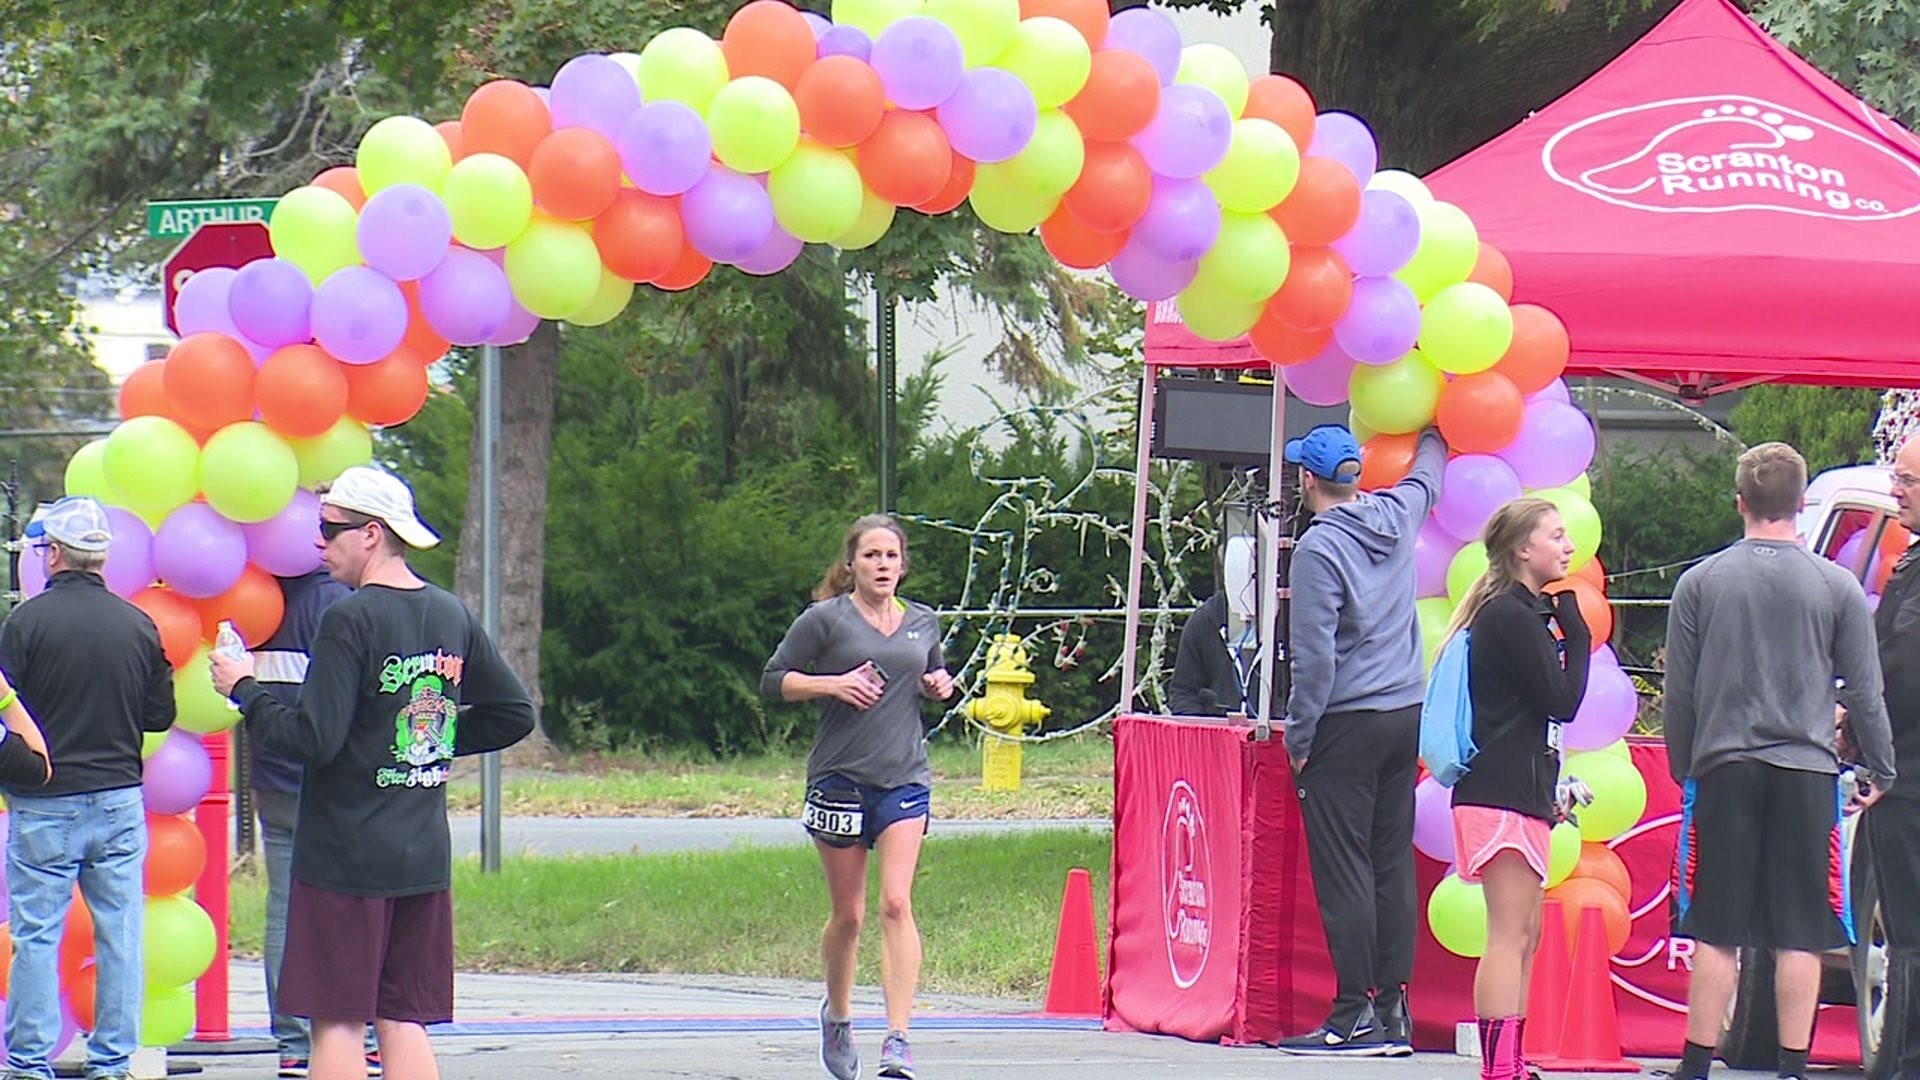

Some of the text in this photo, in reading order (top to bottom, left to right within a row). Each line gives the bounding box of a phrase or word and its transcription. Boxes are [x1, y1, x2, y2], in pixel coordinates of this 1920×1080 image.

[1656, 151, 1846, 187] Scranton
[1660, 173, 1851, 210] Running
[159, 205, 264, 234] ARTHUR
[806, 806, 853, 834] 3903
